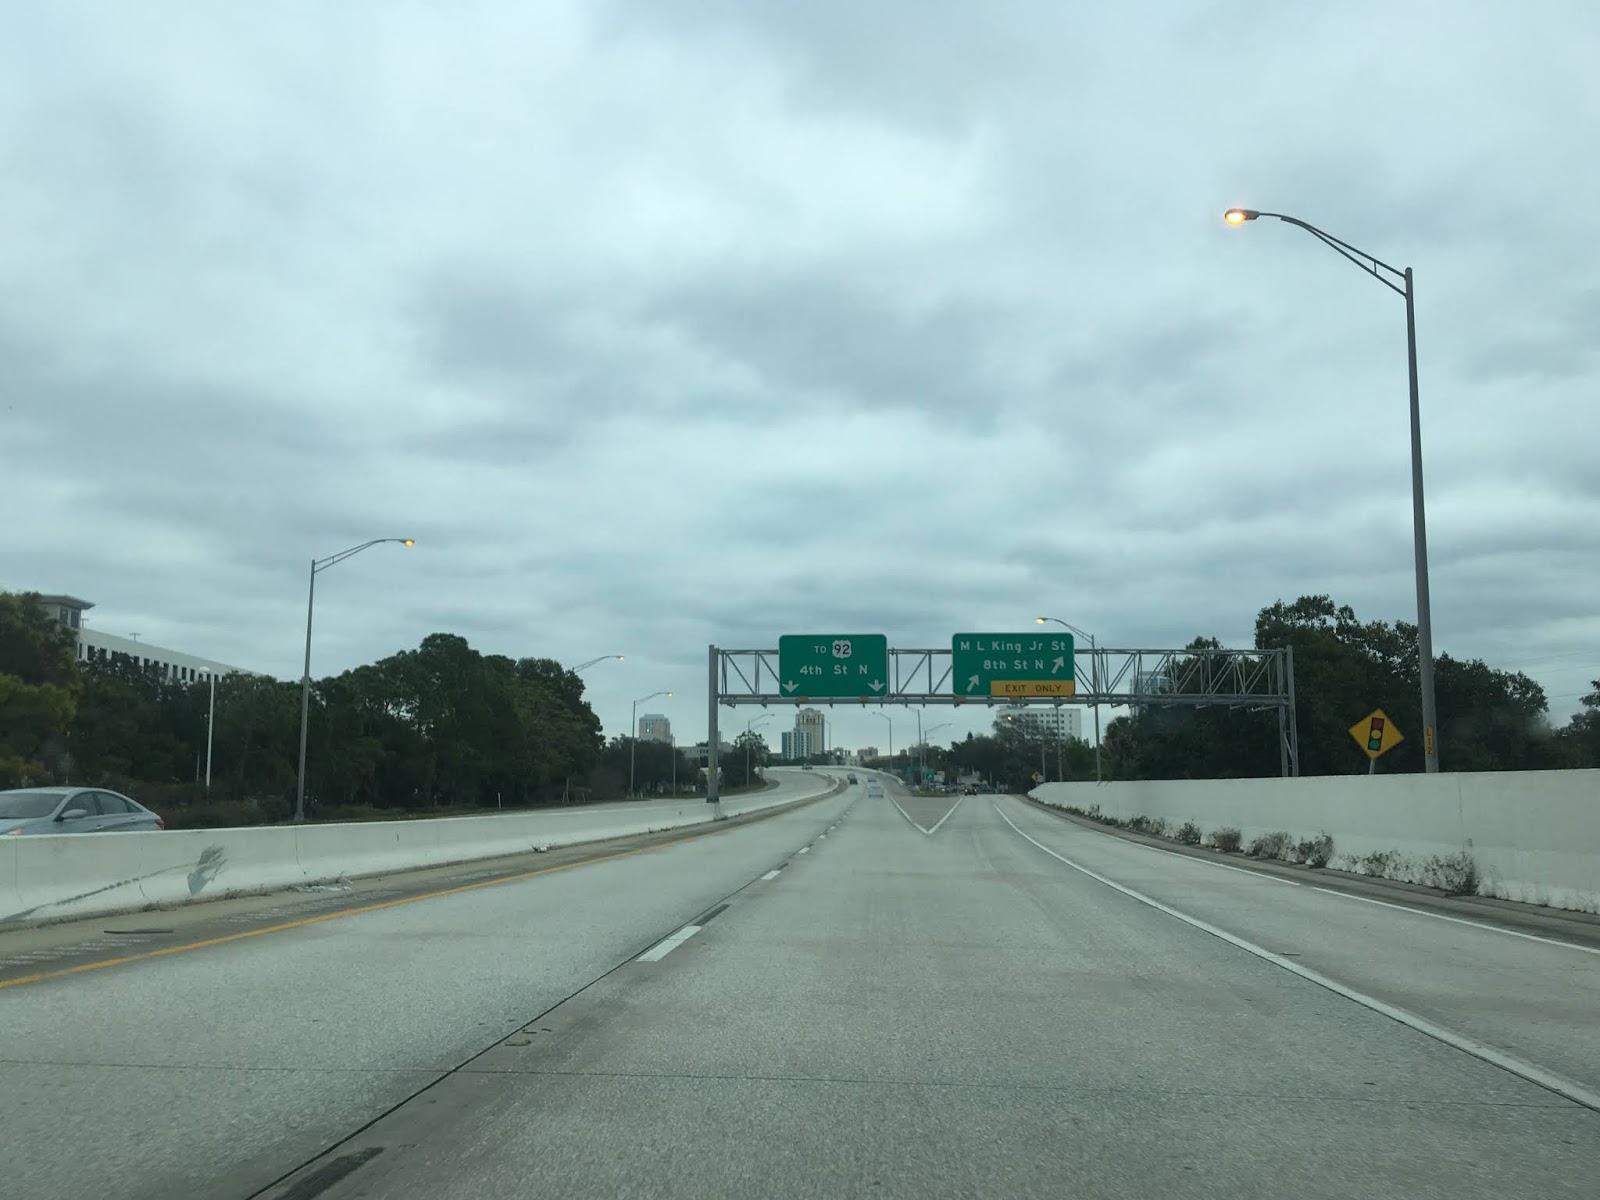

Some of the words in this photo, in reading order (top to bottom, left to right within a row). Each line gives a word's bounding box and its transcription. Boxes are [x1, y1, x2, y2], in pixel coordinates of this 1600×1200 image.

[814, 645, 827, 654] TO
[834, 643, 850, 655] 92
[960, 641, 970, 651] M
[977, 641, 985, 651] L
[991, 641, 1022, 654] King
[1029, 641, 1043, 651] Jr
[1051, 641, 1066, 651] St
[799, 665, 822, 675] 4th
[833, 664, 848, 675] St
[859, 664, 868, 675] N
[983, 659, 1007, 670] 8th
[1014, 660, 1028, 670] St
[1035, 660, 1044, 670] N
[1005, 684, 1027, 693] EXIT
[1035, 684, 1062, 693] ONLY
